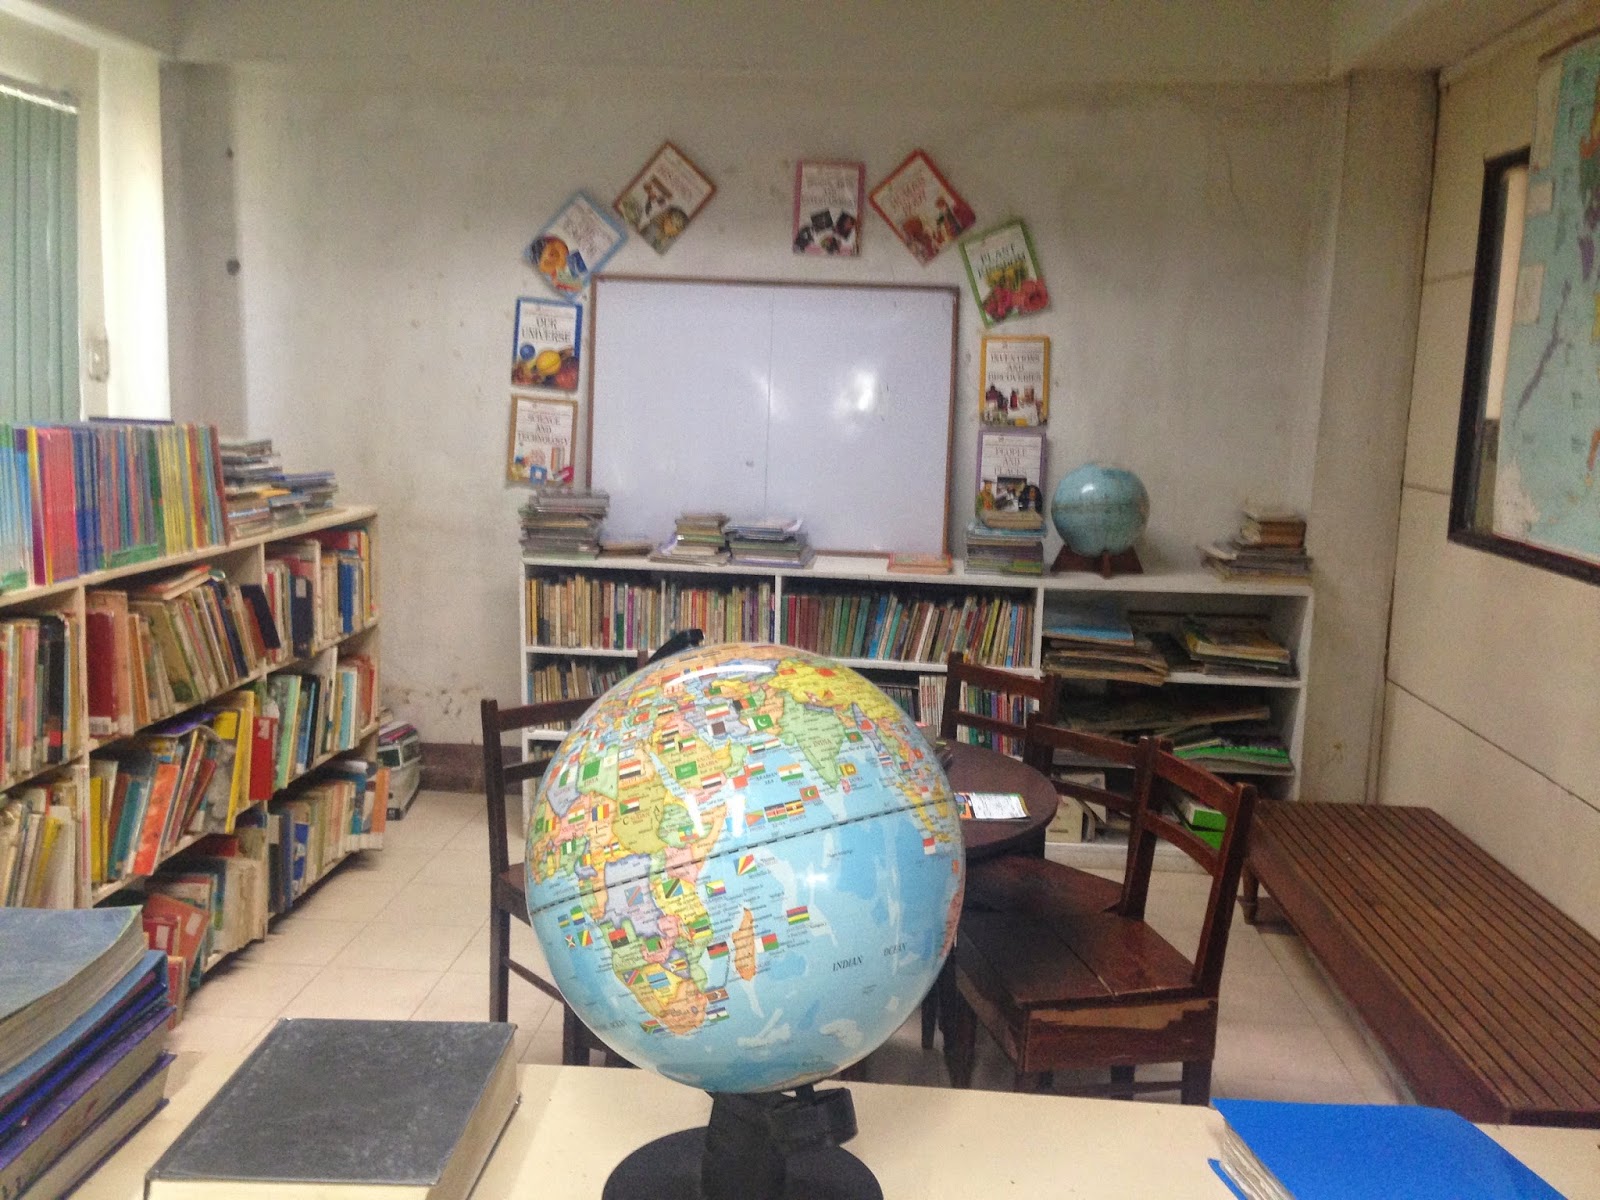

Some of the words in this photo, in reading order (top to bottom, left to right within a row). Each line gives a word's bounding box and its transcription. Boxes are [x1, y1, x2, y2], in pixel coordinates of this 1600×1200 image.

[521, 327, 571, 343] UNIVERSE
[832, 954, 863, 972] INDIAN
[883, 942, 908, 957] OCEAN
